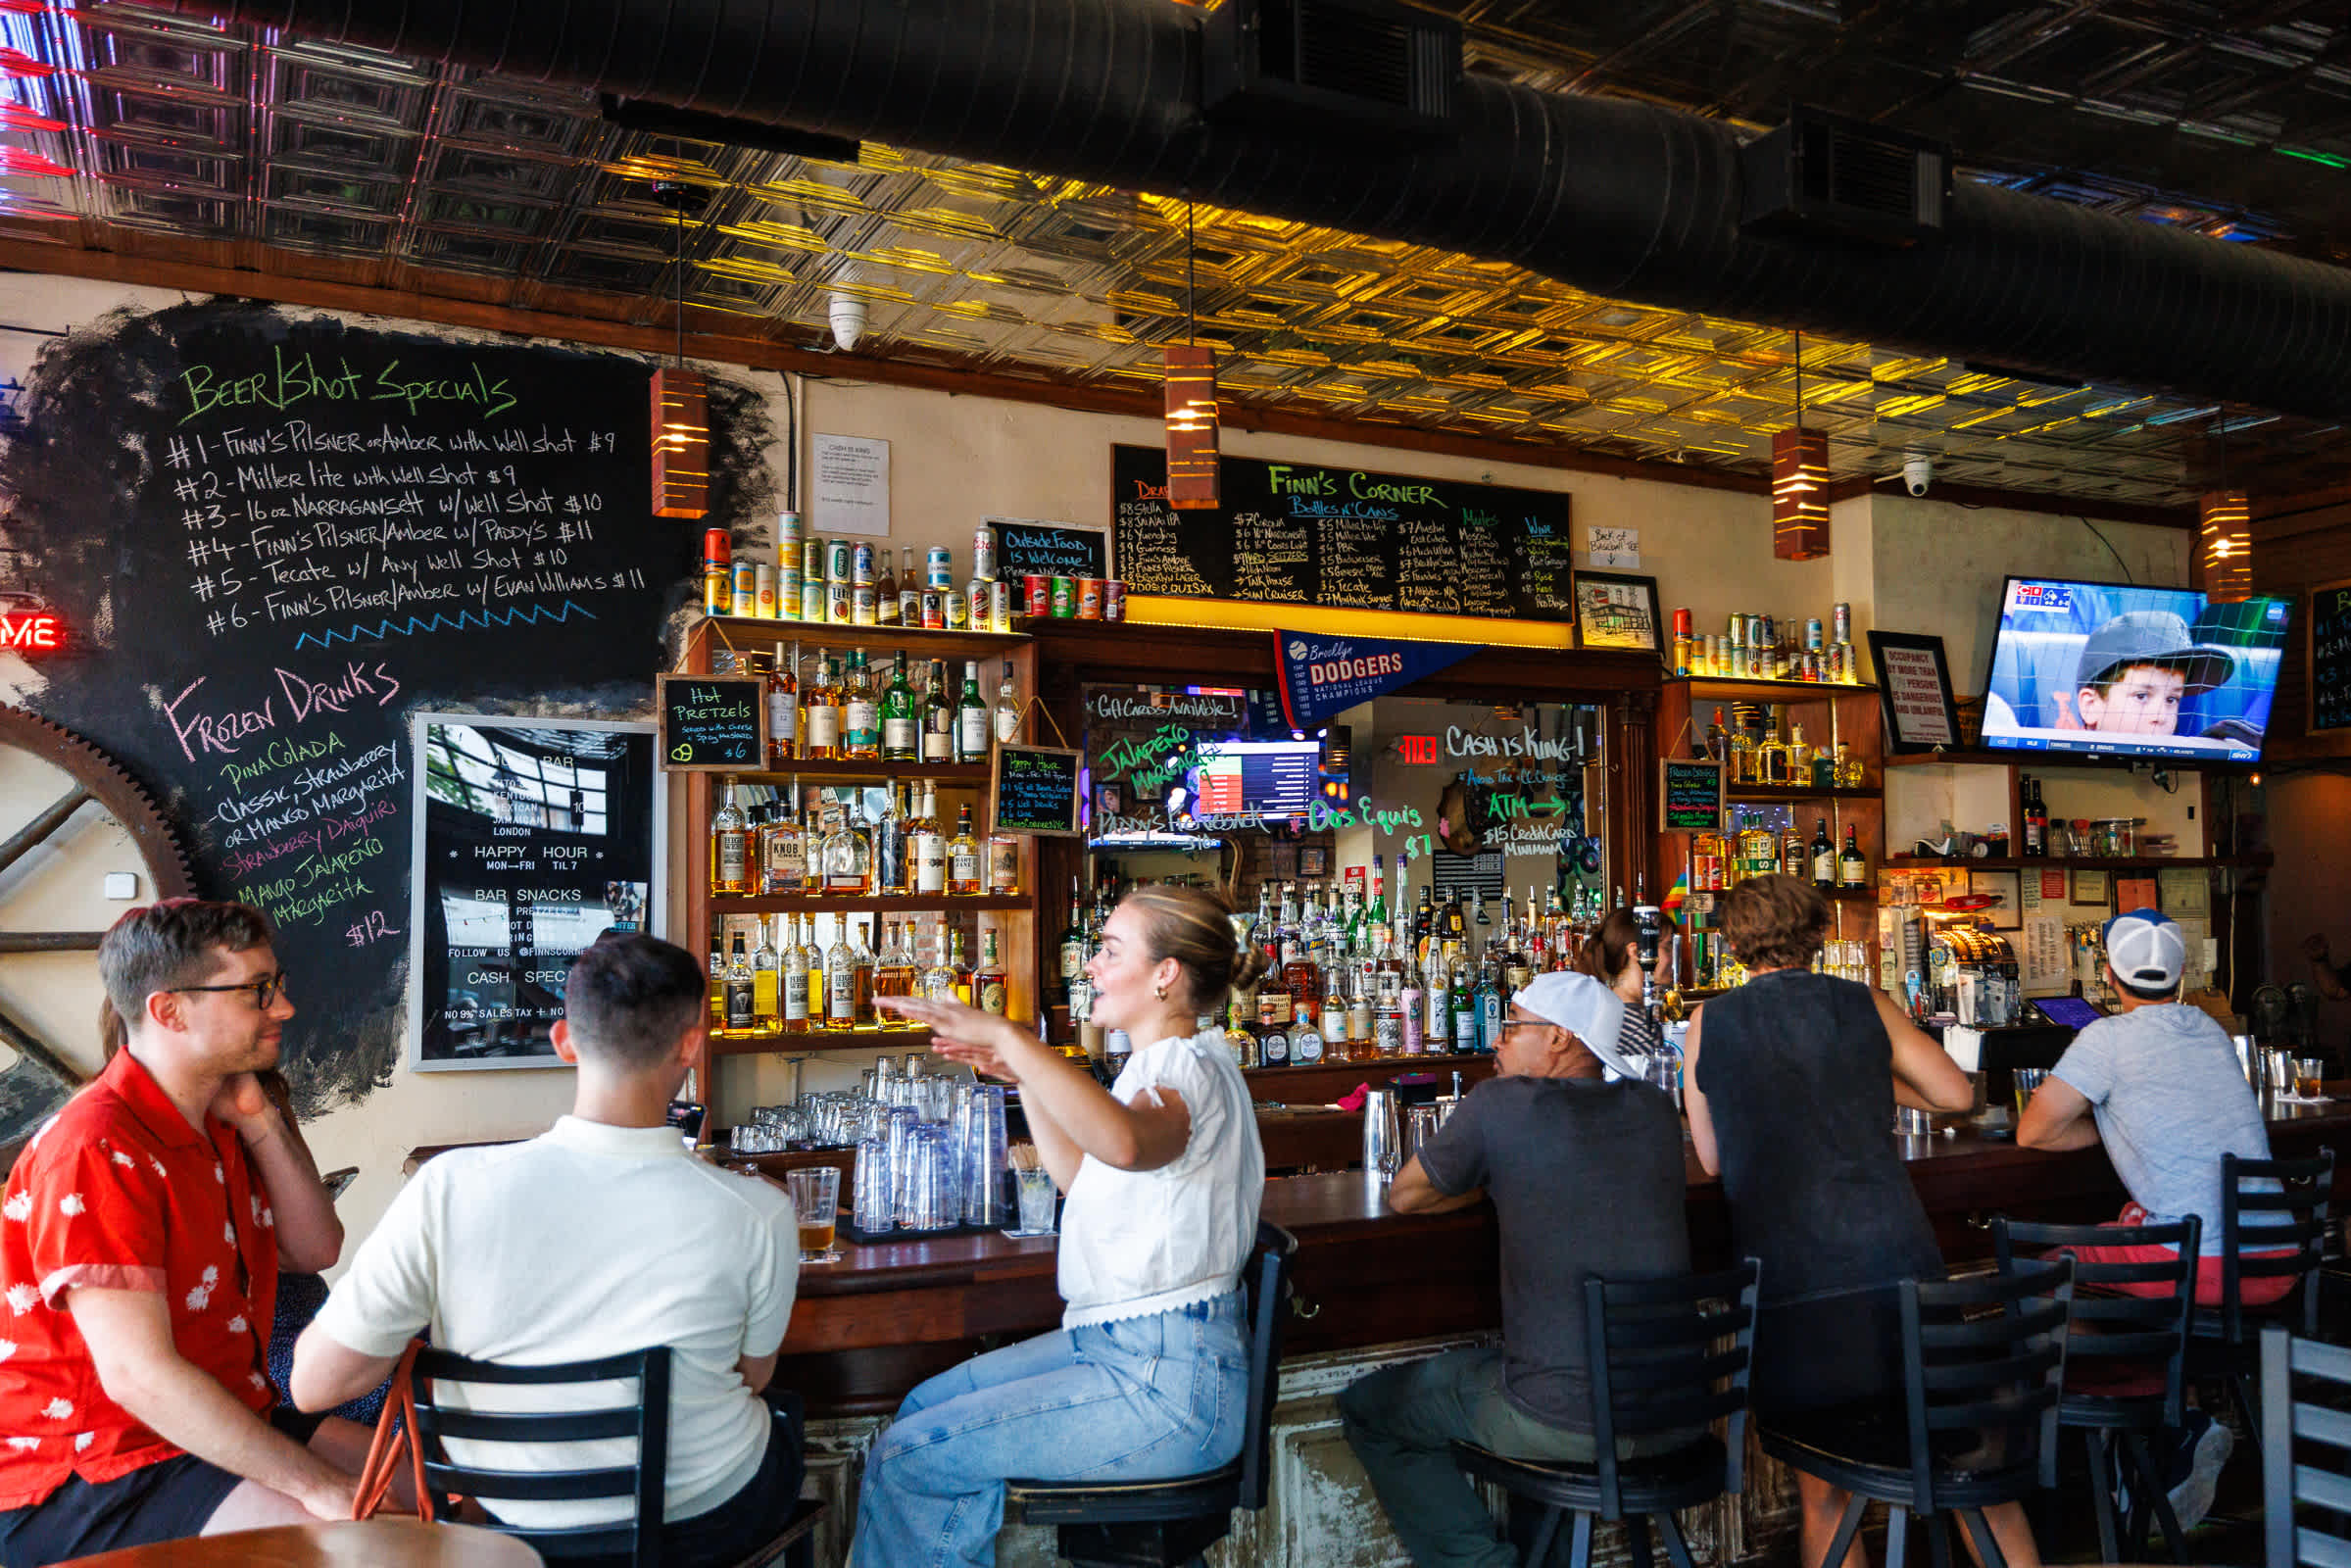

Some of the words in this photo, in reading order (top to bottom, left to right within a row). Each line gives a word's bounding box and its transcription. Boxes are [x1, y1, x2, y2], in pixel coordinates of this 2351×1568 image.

[588, 431, 615, 455] $9
[487, 465, 516, 487] $9
[1348, 471, 1449, 509] CORNER
[564, 493, 603, 514] $10
[557, 519, 593, 543] $11
[262, 558, 336, 584] Tecate
[533, 548, 567, 566] $10
[612, 567, 645, 591] $11
[1888, 651, 1929, 663] OCCUPANCY
[1309, 653, 1402, 686] DODGERS
[1898, 664, 1918, 675] MORE
[1919, 666, 1936, 676] THAN
[1314, 682, 1352, 693] NATIONAL
[1354, 676, 1383, 688] LEAGUE
[1906, 678, 1938, 690] PERSONS
[1315, 685, 1373, 702] CHAMPIONS
[1901, 692, 1941, 704] DANGEROUS
[164, 675, 275, 762] FROZEN
[274, 662, 400, 723] DRINKS
[725, 742, 746, 759] $6
[1309, 800, 1356, 831] Dos
[1358, 795, 1423, 835] Equis
[1488, 791, 1531, 822] ATM
[493, 827, 531, 836] LONDON
[1482, 823, 1508, 846] $15
[474, 846, 527, 858] HAPPY
[543, 846, 588, 858] HOUR
[773, 843, 799, 854] KNOB
[1405, 833, 1432, 859] $7
[552, 860, 568, 870] TIL
[570, 861, 578, 870] 7
[475, 889, 507, 902] BAR
[516, 889, 581, 902] SNACKS
[345, 909, 401, 947] $12
[448, 948, 488, 957] FOLLOW
[497, 948, 511, 956] US
[467, 971, 510, 985] CASH
[444, 1010, 458, 1019] NO
[478, 1008, 513, 1019] SALES
[514, 1008, 532, 1017] TAX
[550, 1007, 564, 1016] NO
